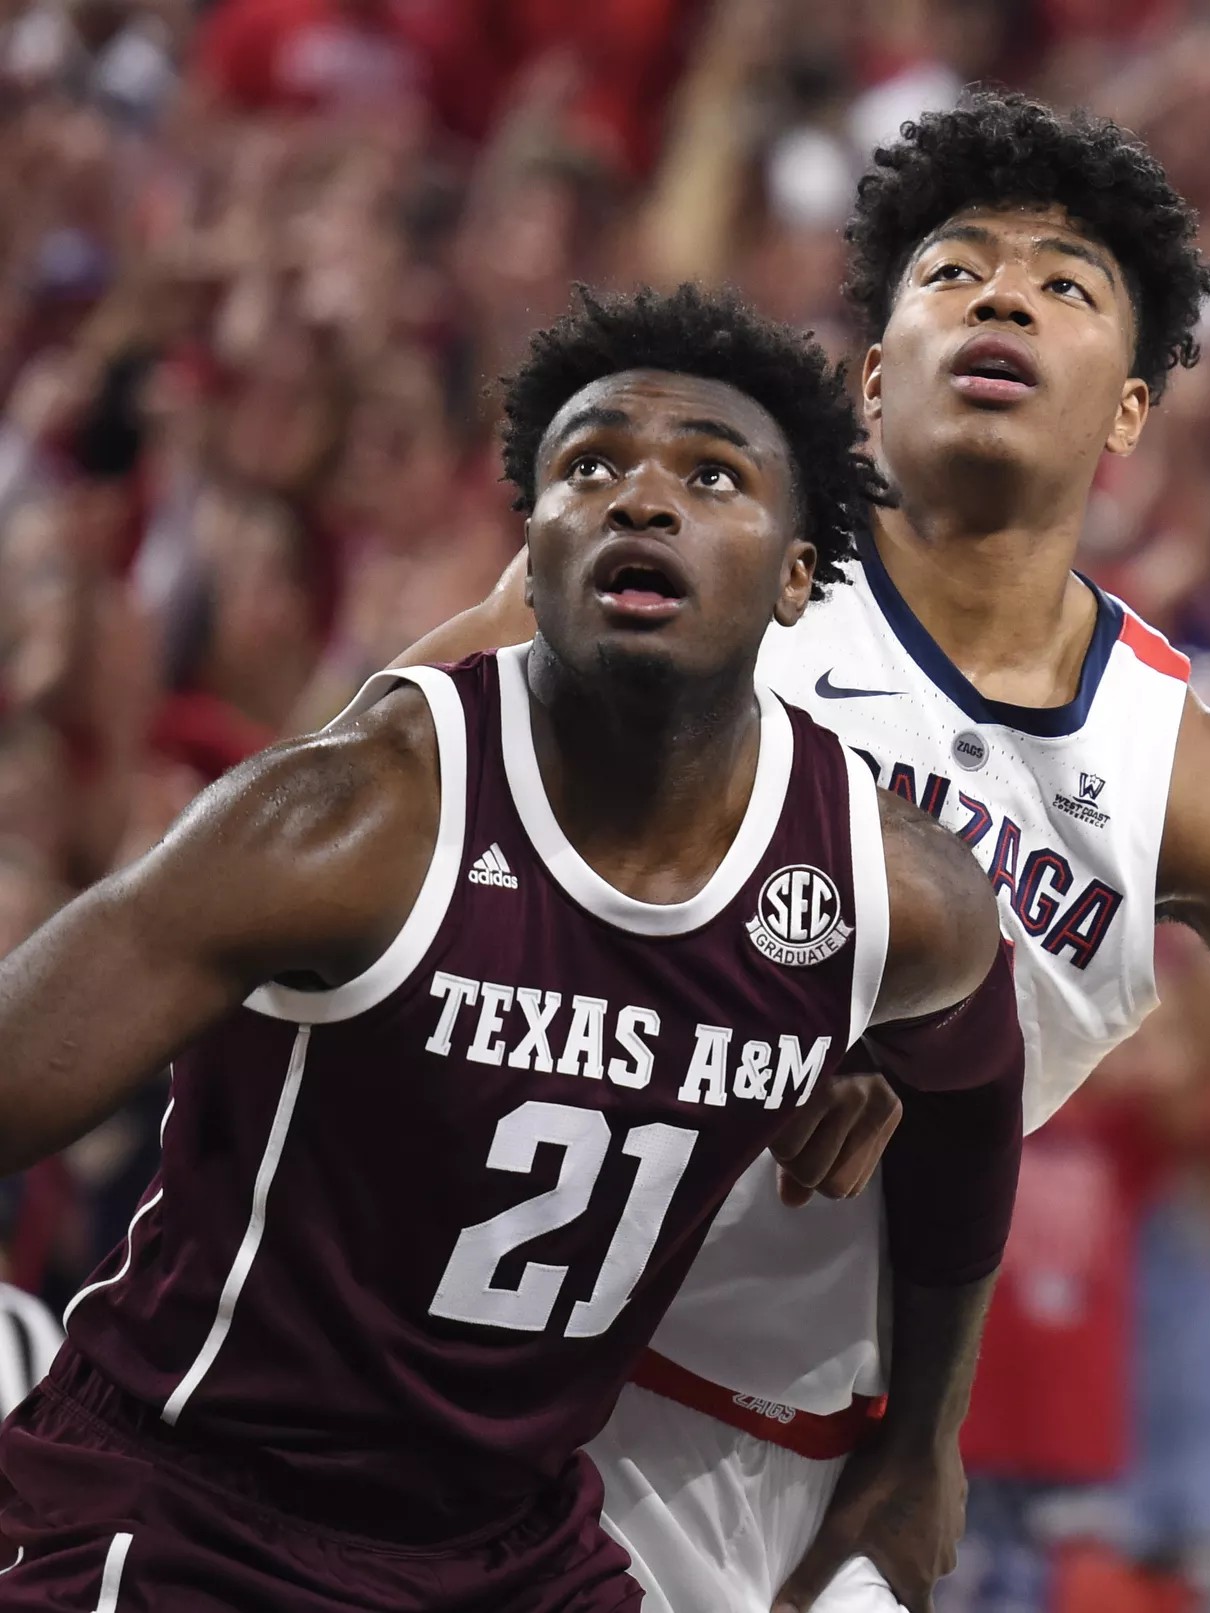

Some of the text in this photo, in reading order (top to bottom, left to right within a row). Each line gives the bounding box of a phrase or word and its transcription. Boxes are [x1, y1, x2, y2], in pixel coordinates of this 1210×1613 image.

[956, 740, 984, 759] ZAGS
[1052, 801, 1105, 829] CONFERENCE
[1055, 793, 1111, 824] WEST COAST
[468, 868, 518, 890] adidas
[766, 870, 833, 941] SEC
[756, 935, 838, 965] GRADUATE
[424, 970, 832, 1110] TEXAS A&M
[428, 1100, 699, 1338] 21
